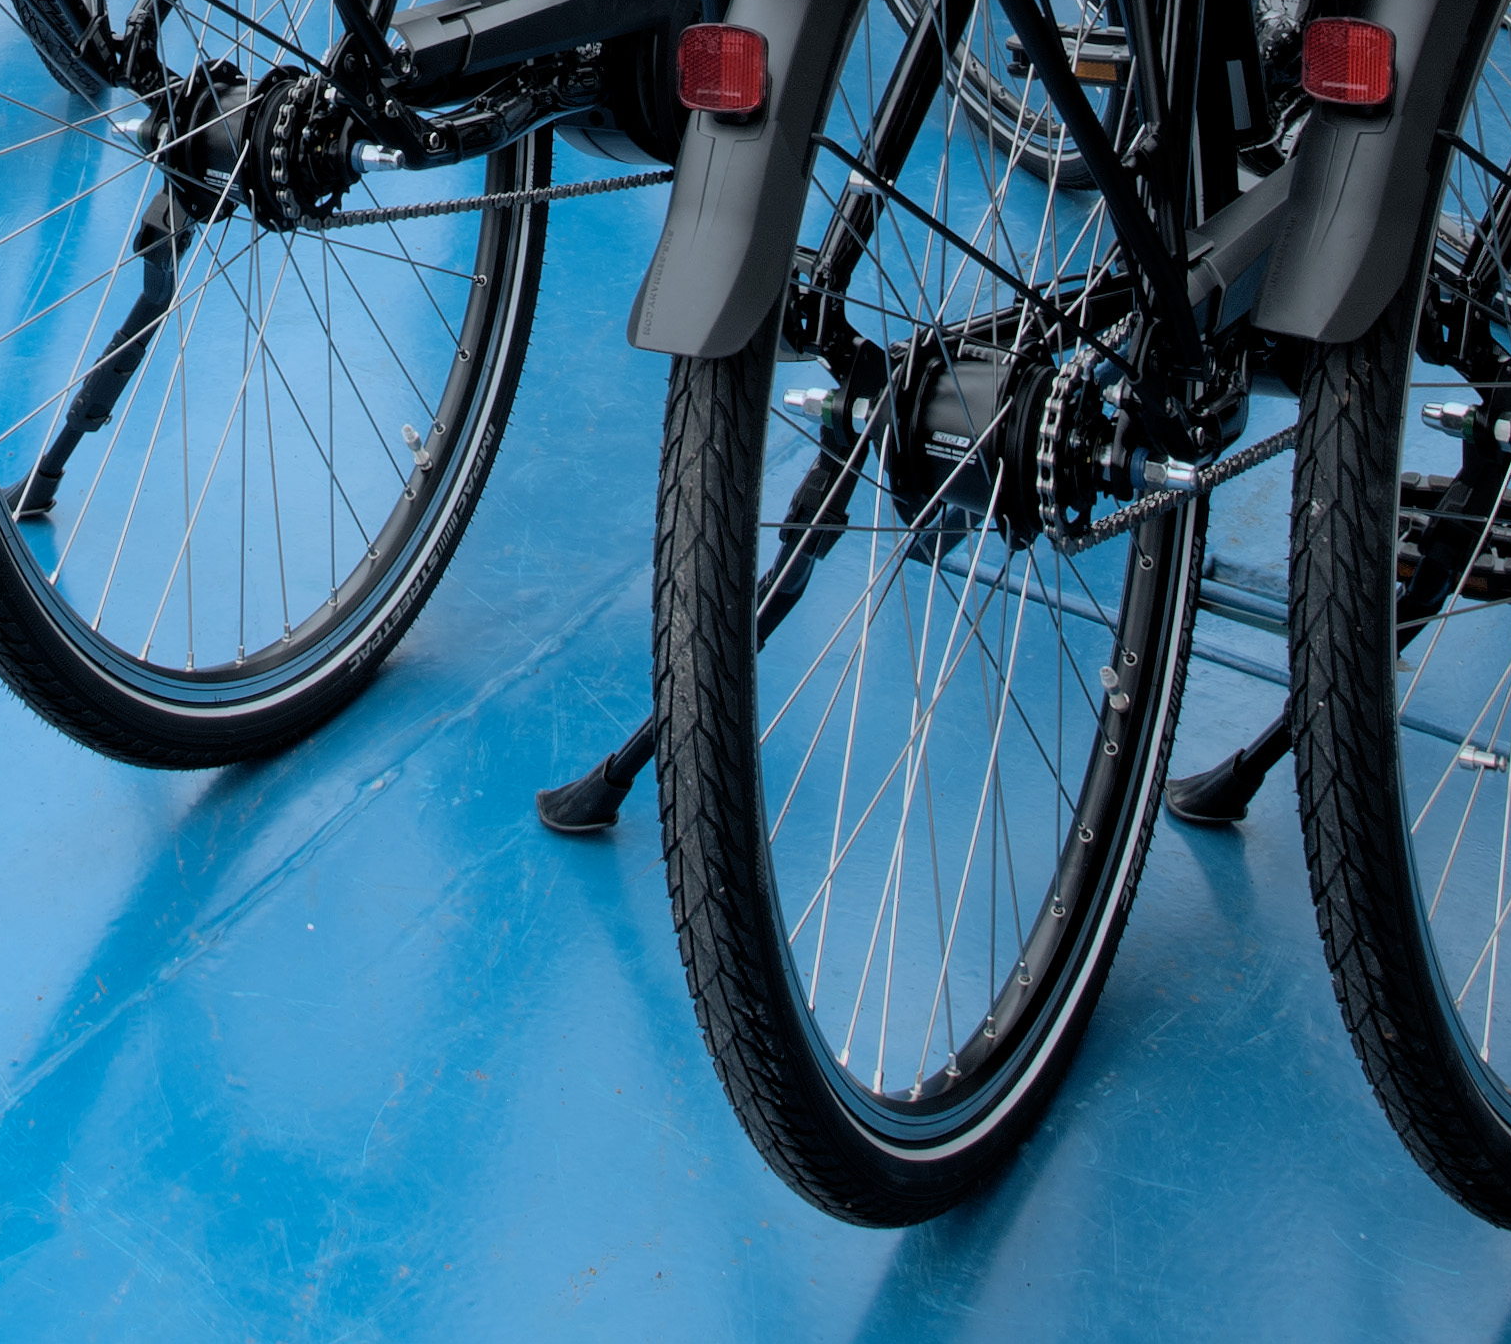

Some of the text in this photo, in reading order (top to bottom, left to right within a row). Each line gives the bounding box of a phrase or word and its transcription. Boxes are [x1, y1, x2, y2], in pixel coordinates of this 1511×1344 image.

[348, 422, 497, 673] IMPAC STREETPAC
[1119, 713, 1176, 912] STREETPAC
